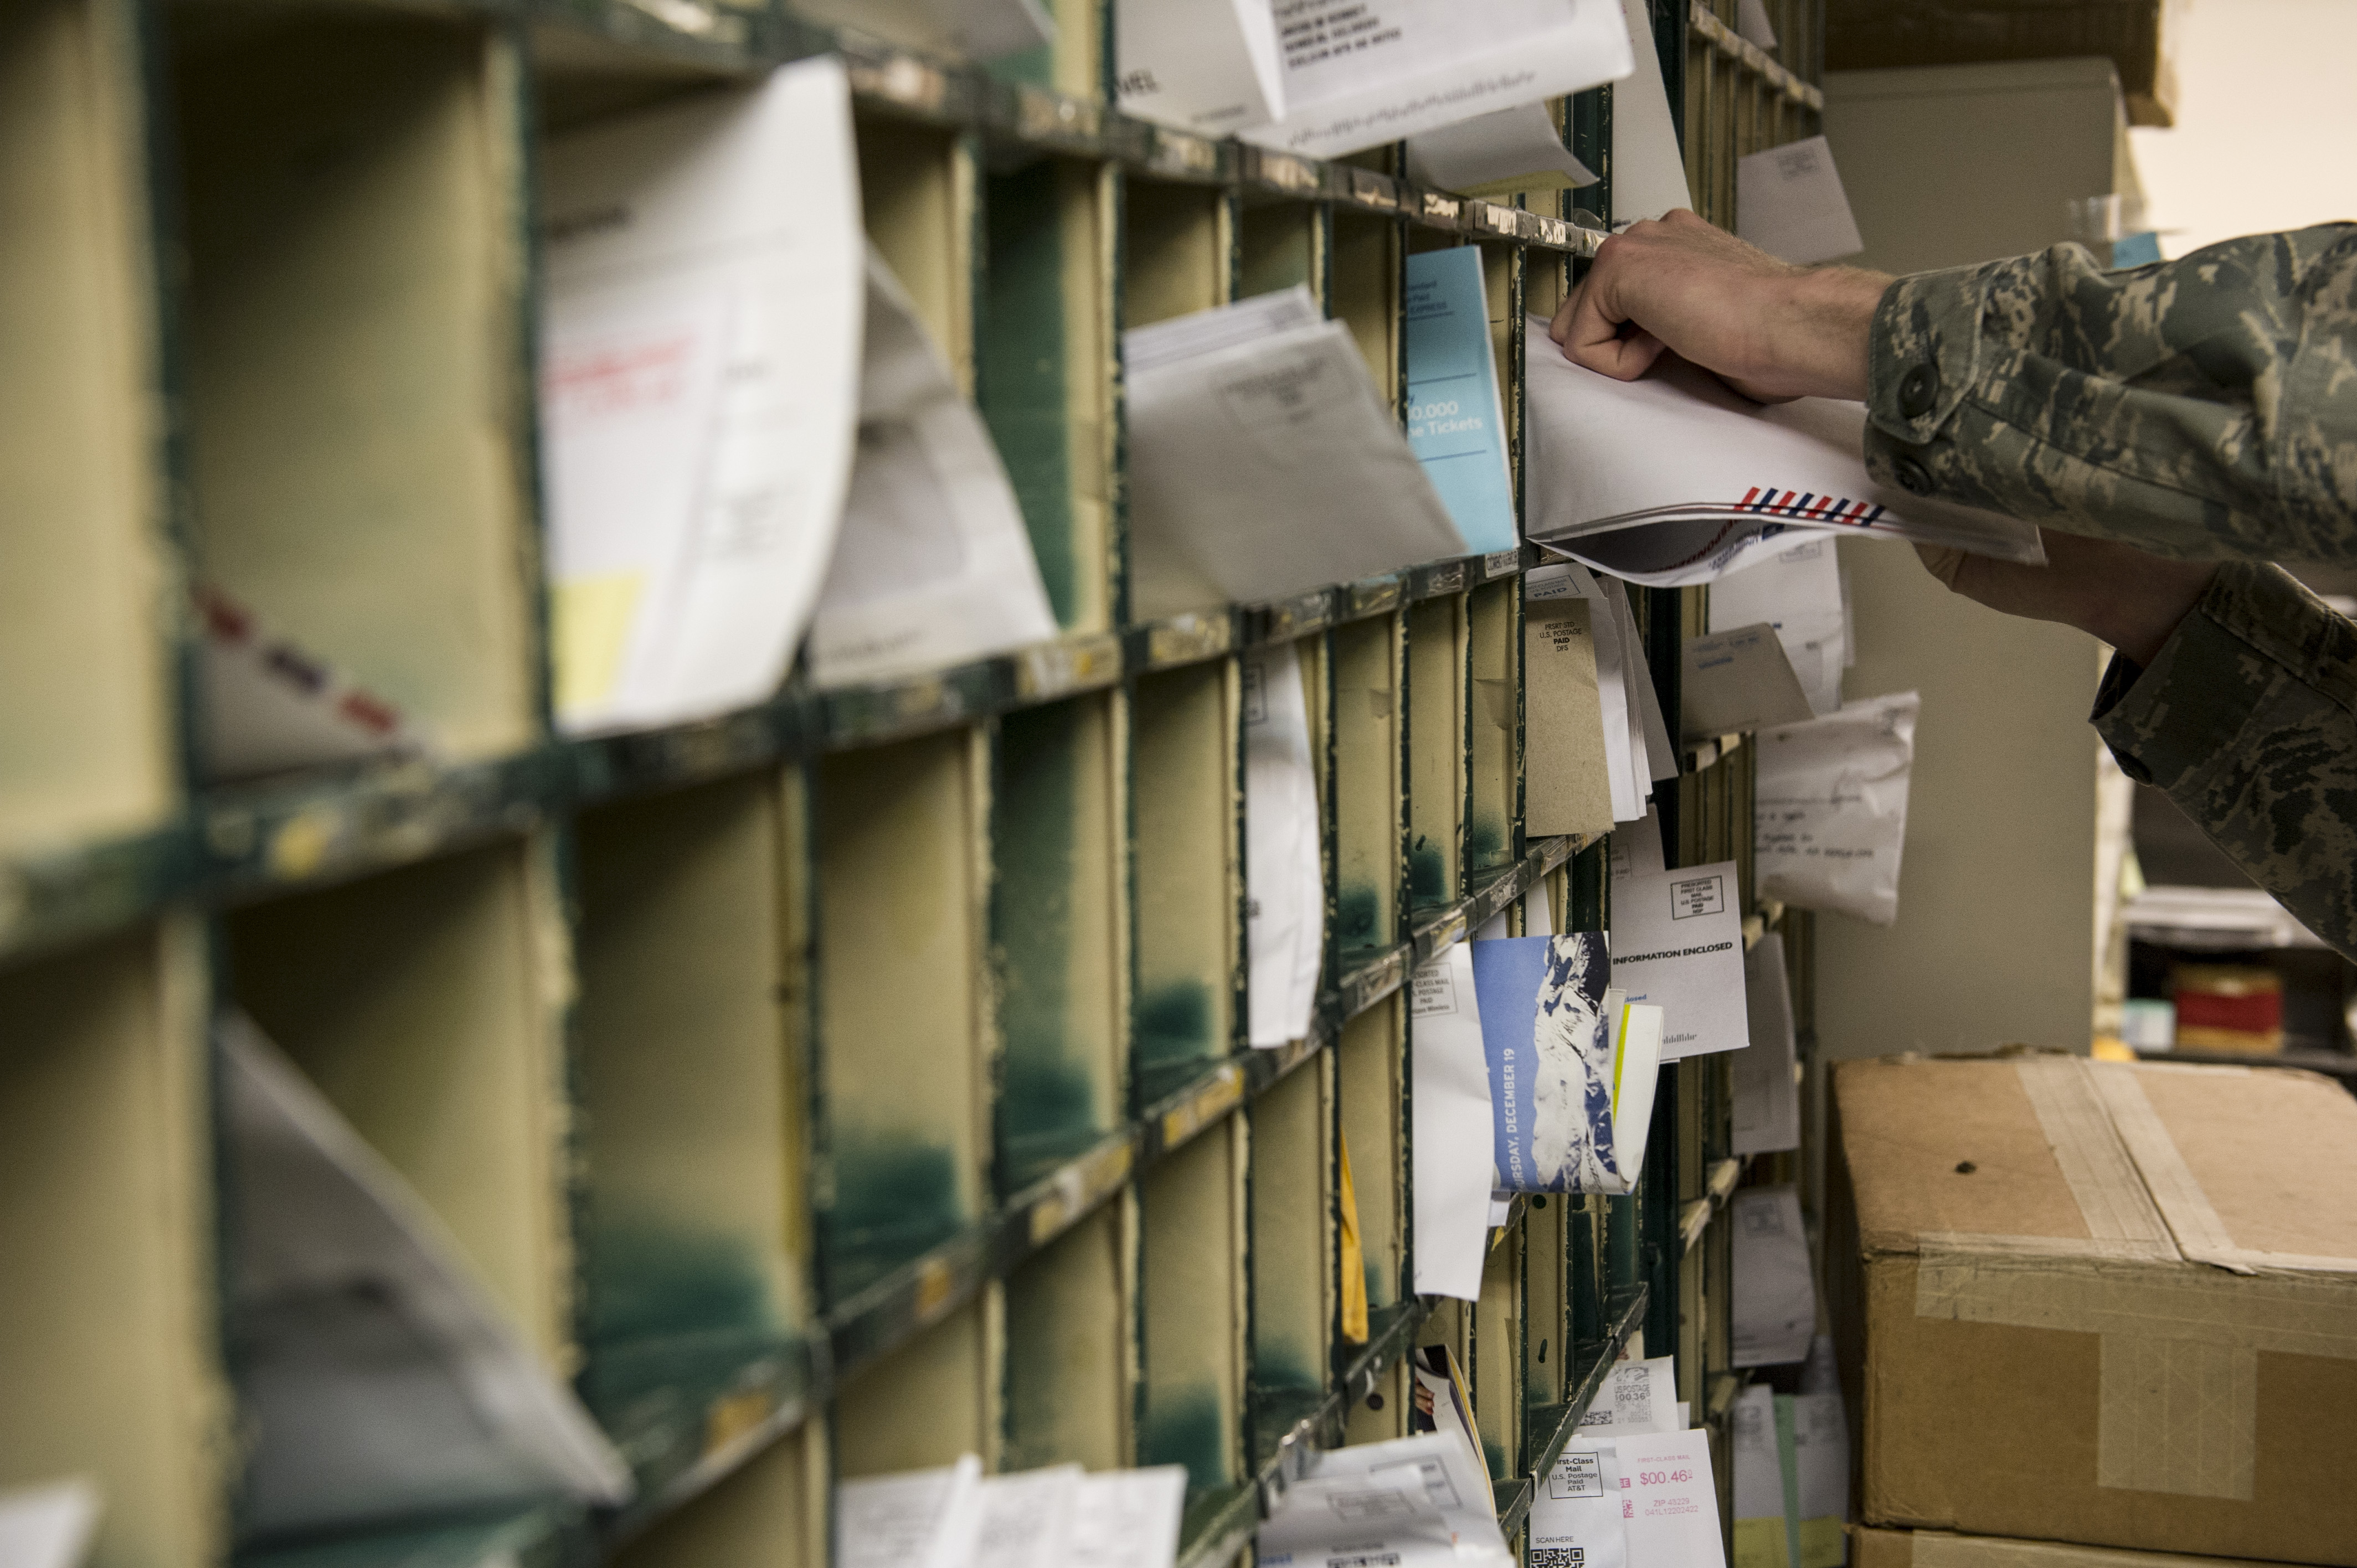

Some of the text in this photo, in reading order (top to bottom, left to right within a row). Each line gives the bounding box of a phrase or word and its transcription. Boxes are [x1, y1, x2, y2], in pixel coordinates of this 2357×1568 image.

[1428, 416, 1483, 435] Tickets
[1533, 587, 1567, 597] PAID
[1553, 628, 1582, 637] POSTAGE
[1691, 895, 1715, 903] POSTAGE
[1613, 942, 1733, 965] INFORMATION ENCLOSED
[1418, 987, 1444, 996] POSTAGE
[1503, 1048, 1515, 1061] 19
[1503, 1064, 1517, 1134] DECEMBER
[1638, 1455, 1675, 1463] FIRST-CLASS
